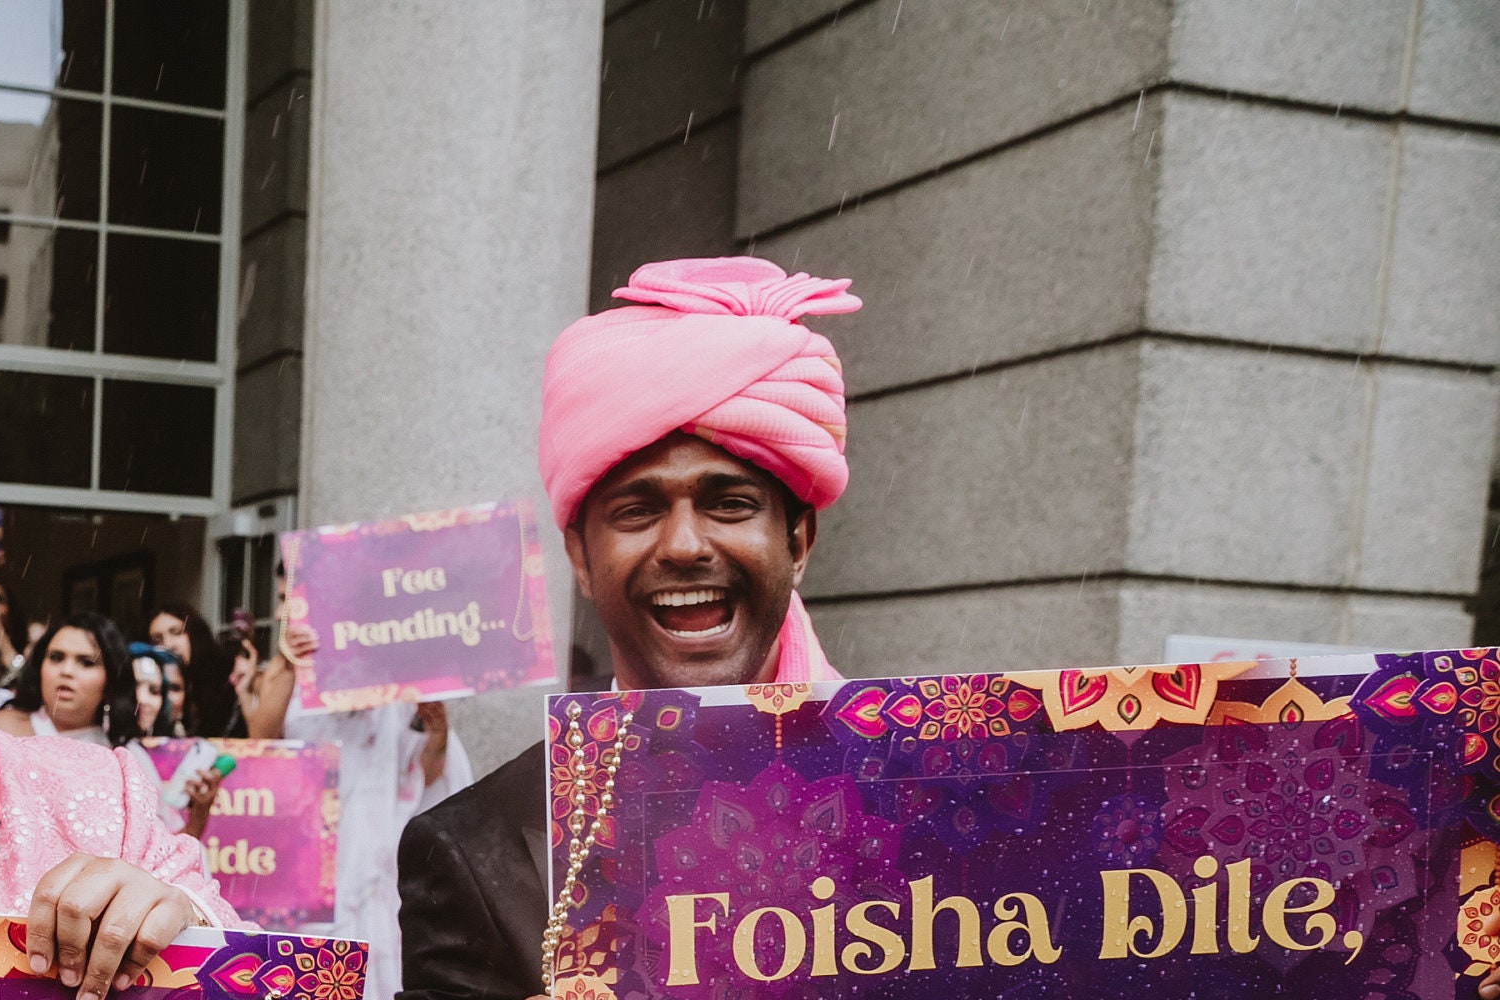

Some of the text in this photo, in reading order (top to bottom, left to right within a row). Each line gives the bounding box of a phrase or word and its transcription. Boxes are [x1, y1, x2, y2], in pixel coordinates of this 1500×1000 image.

[381, 566, 446, 598] Fee
[332, 601, 506, 650] Pending...
[209, 786, 276, 817] am
[206, 836, 277, 876] ide
[663, 855, 1364, 987] Foisha Dile,
